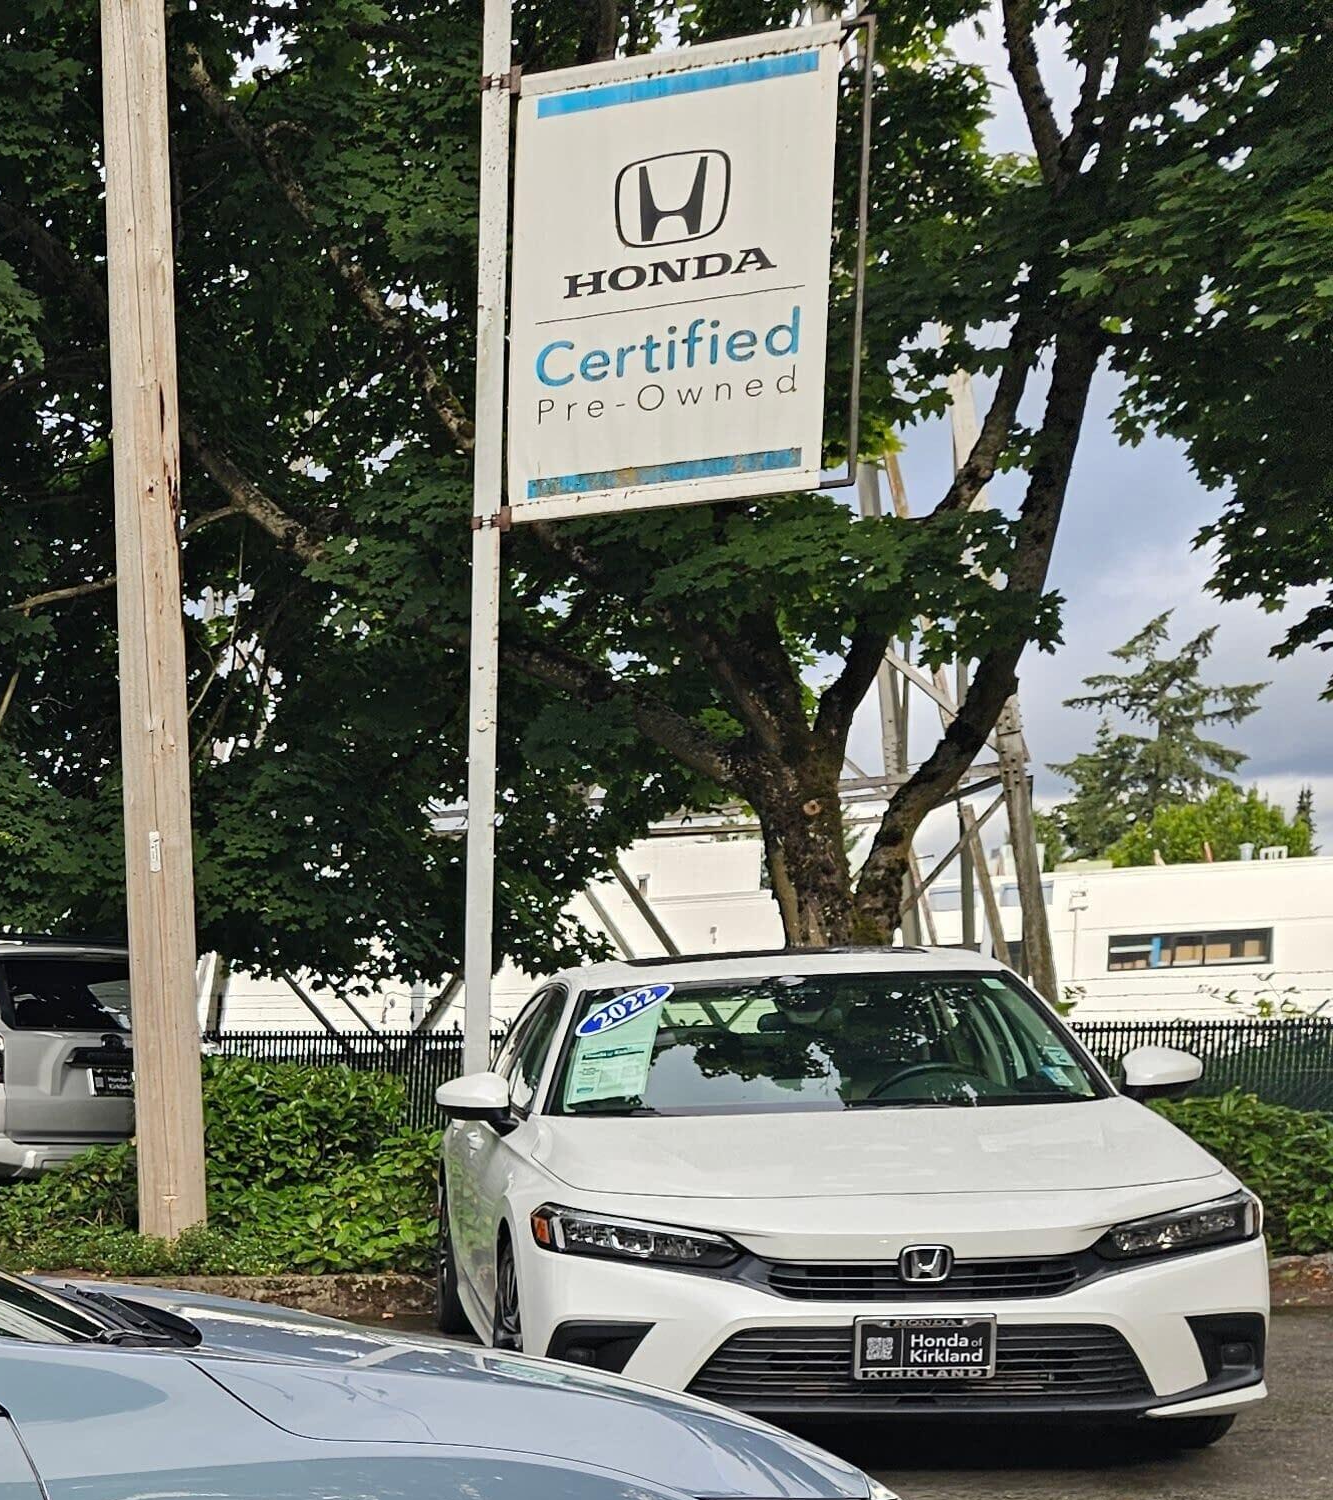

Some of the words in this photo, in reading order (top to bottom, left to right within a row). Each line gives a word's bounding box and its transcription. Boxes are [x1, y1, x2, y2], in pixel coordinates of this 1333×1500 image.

[563, 248, 777, 299] HONDA
[536, 306, 800, 387] Certified
[537, 365, 797, 425] Pre-Owned
[593, 989, 657, 1029] 2022
[893, 1318, 958, 1328] HONDA
[910, 1333, 969, 1348] Honda
[971, 1337, 983, 1348] of
[910, 1348, 983, 1363] Kirkland
[867, 1369, 982, 1378] KIRKLAND
